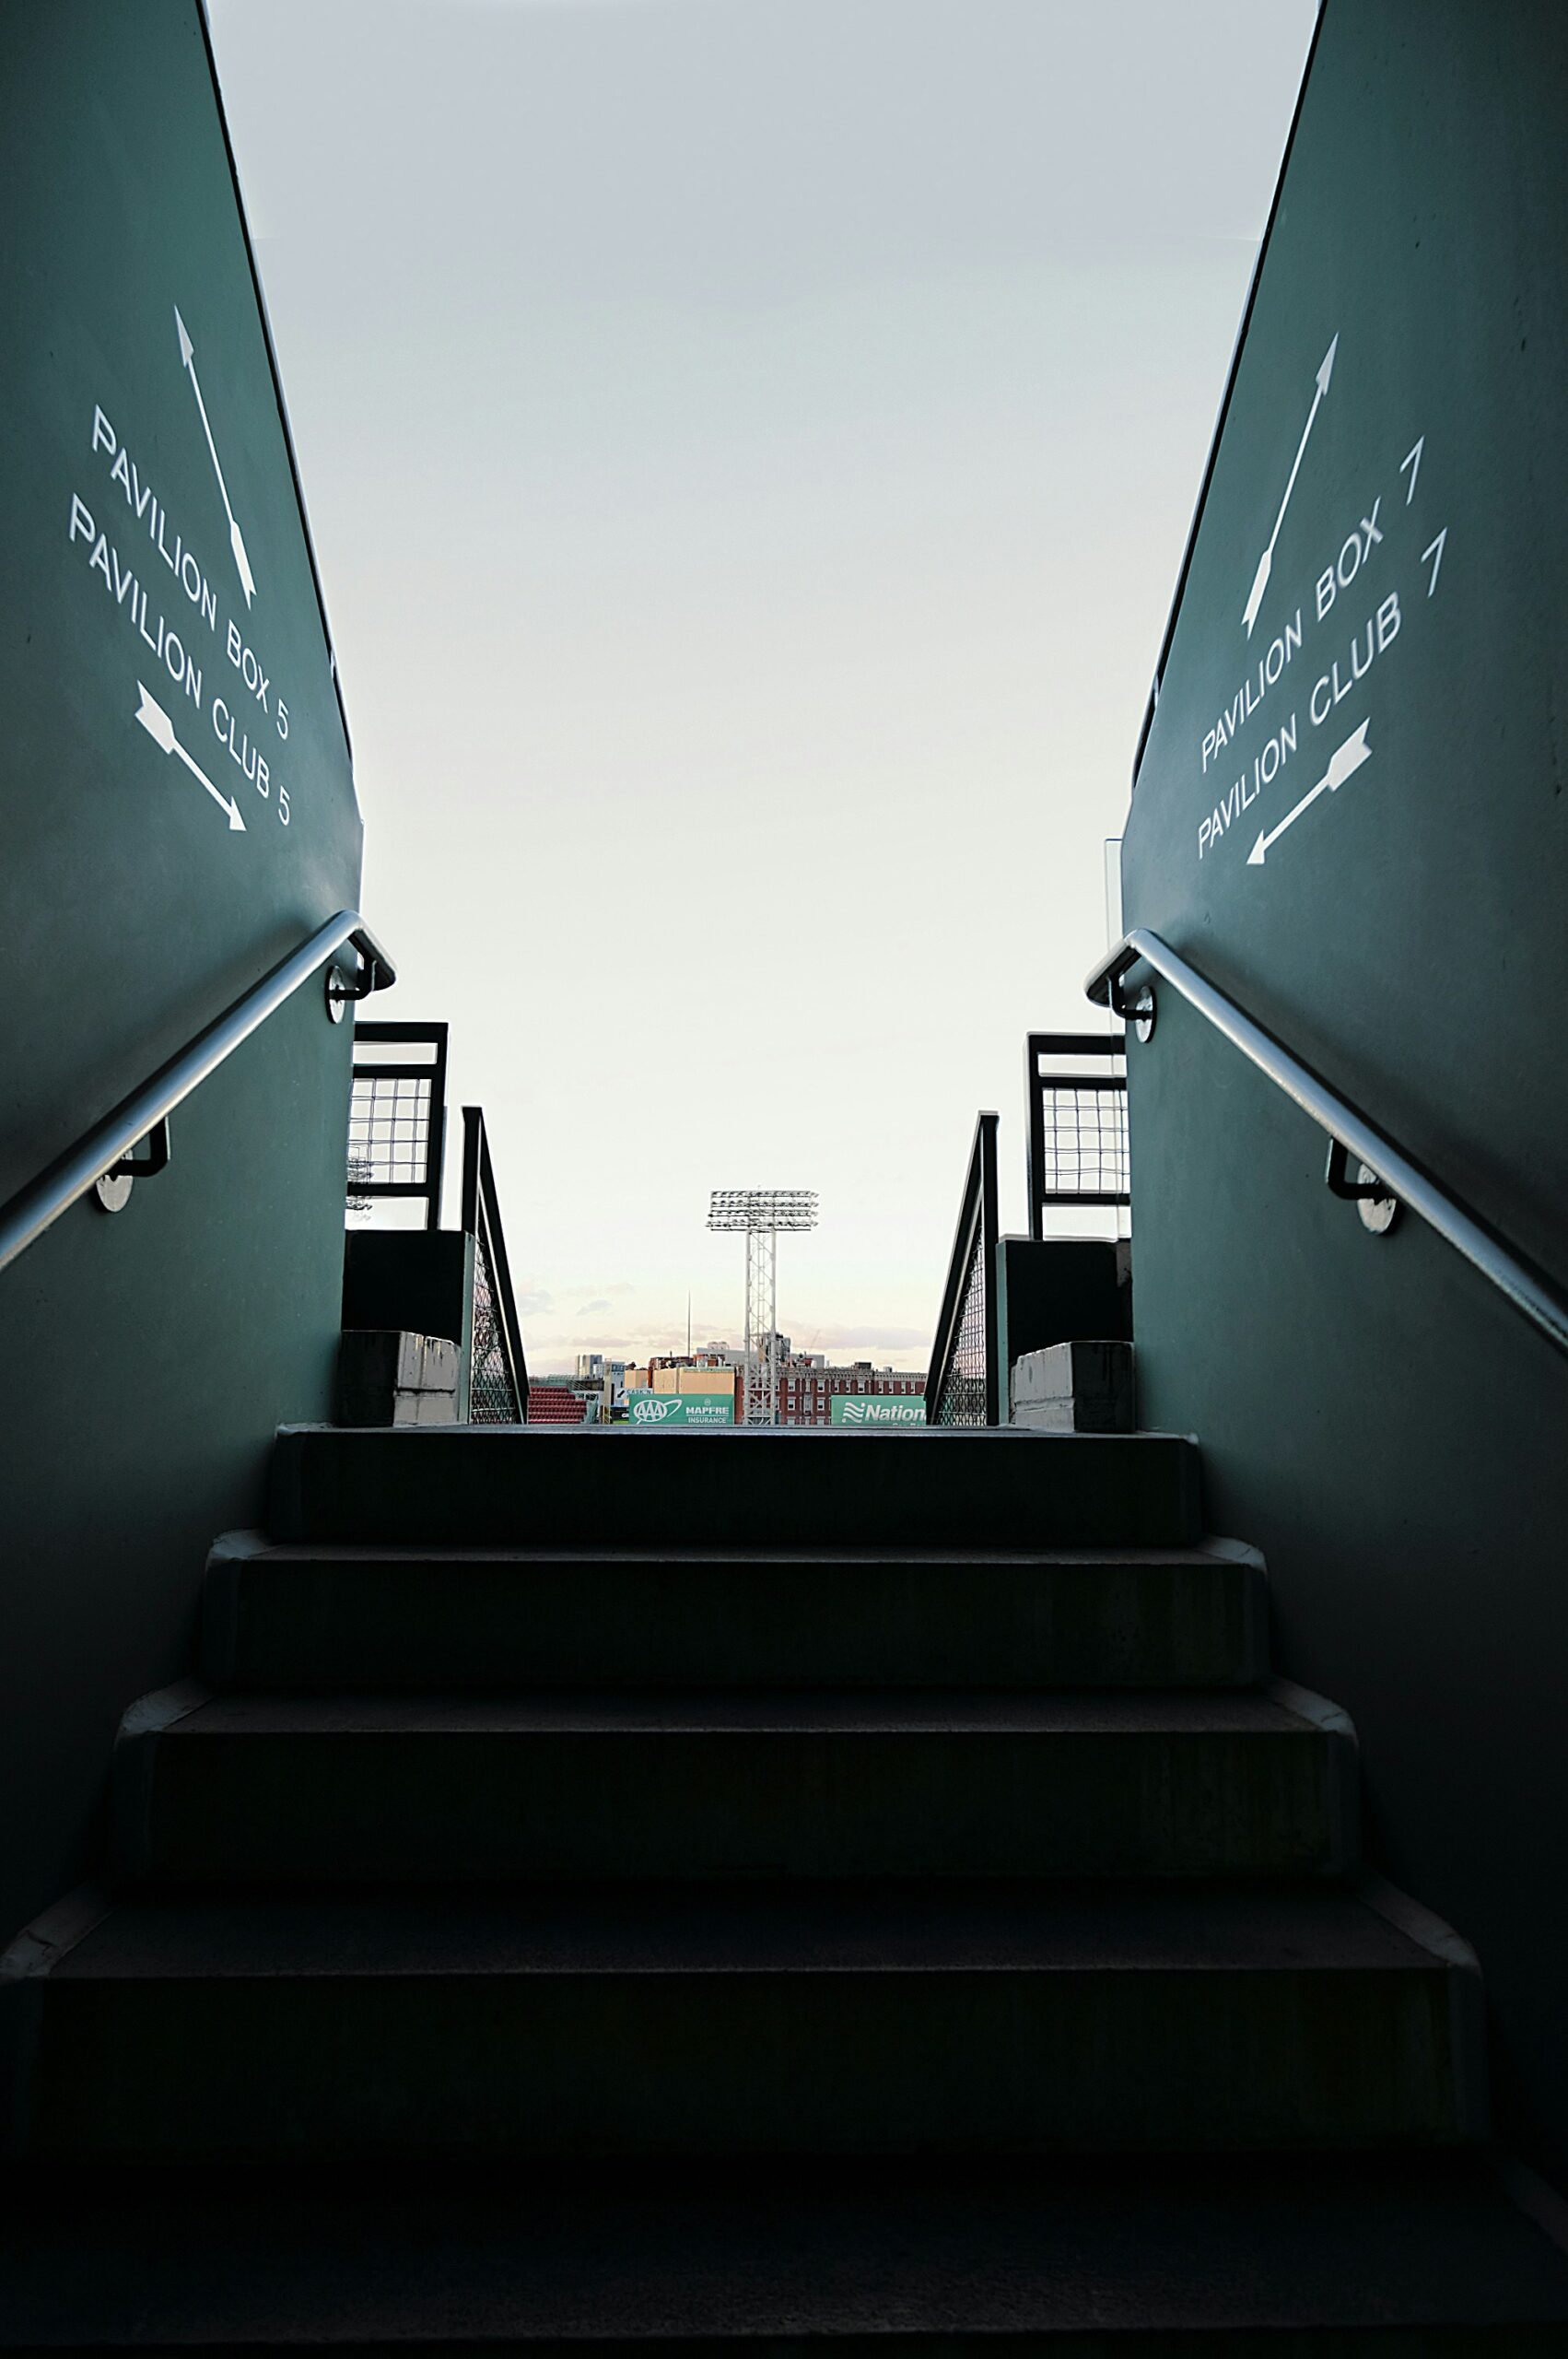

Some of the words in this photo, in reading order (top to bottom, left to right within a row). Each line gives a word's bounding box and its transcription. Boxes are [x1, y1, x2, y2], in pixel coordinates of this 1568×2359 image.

[69, 492, 203, 710] PAVILION
[212, 698, 270, 799] CLUB
[277, 785, 290, 827] 5
[91, 404, 217, 632] PAVILION
[227, 618, 270, 714] BOX
[275, 698, 290, 741] 5
[1198, 712, 1297, 860] PAVILION
[1309, 591, 1402, 726] CLUB
[1421, 526, 1448, 598] 7
[1201, 607, 1303, 774] PAVILION
[1316, 495, 1384, 623] BOX
[1398, 435, 1425, 506] 7
[638, 1400, 664, 1421] AAA
[685, 1406, 730, 1415] MAPFRE
[864, 1404, 927, 1422] Nation
